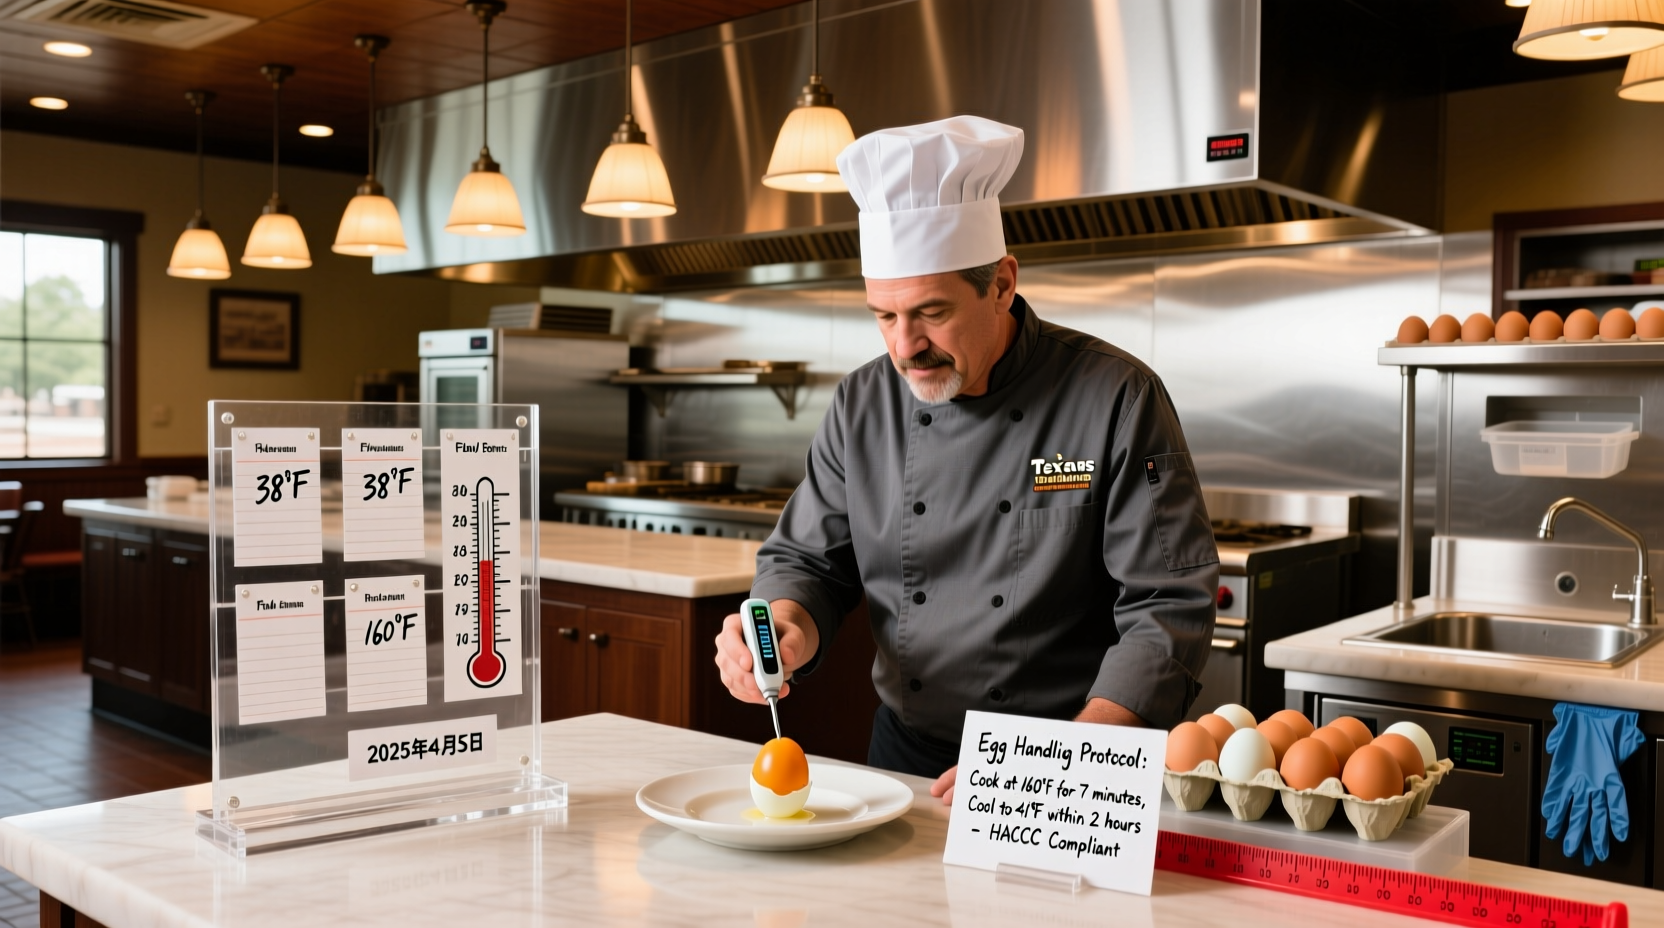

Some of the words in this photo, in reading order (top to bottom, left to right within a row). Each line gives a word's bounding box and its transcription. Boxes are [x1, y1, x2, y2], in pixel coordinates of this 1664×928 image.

[367, 731, 483, 764] 2025年4月5日
[978, 732, 1007, 765] Egg
[1014, 735, 1073, 771] Handlig
[1080, 742, 1147, 769] Protocol:
[969, 769, 1000, 789] Cook
[1003, 775, 1018, 791] at
[1057, 780, 1076, 799] for
[1080, 783, 1089, 799] 7
[1092, 787, 1146, 810] minutes,
[968, 794, 996, 814] Cool
[999, 801, 1012, 816] to
[1047, 807, 1085, 826] within
[1089, 811, 1099, 828] 2
[1104, 812, 1142, 834] hours
[989, 823, 1042, 846] HACCC
[1049, 831, 1121, 858] Compliant
